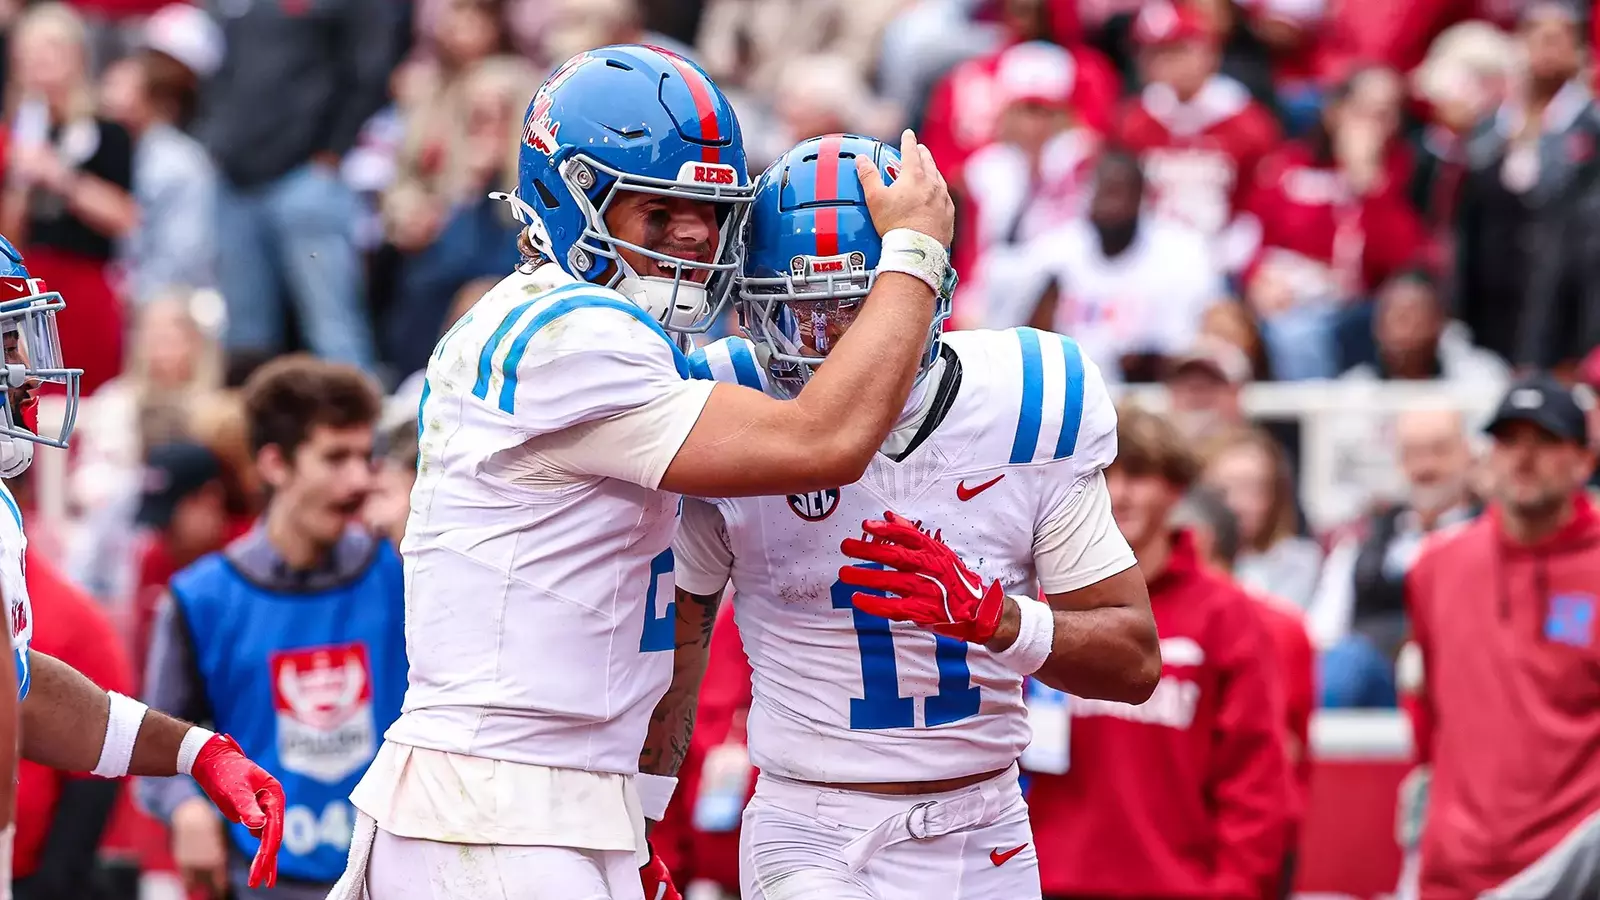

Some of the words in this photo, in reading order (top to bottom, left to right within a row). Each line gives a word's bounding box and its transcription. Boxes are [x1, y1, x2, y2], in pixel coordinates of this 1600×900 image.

[694, 166, 734, 184] REBS
[813, 261, 843, 272] REBS
[793, 489, 835, 517] SEC
